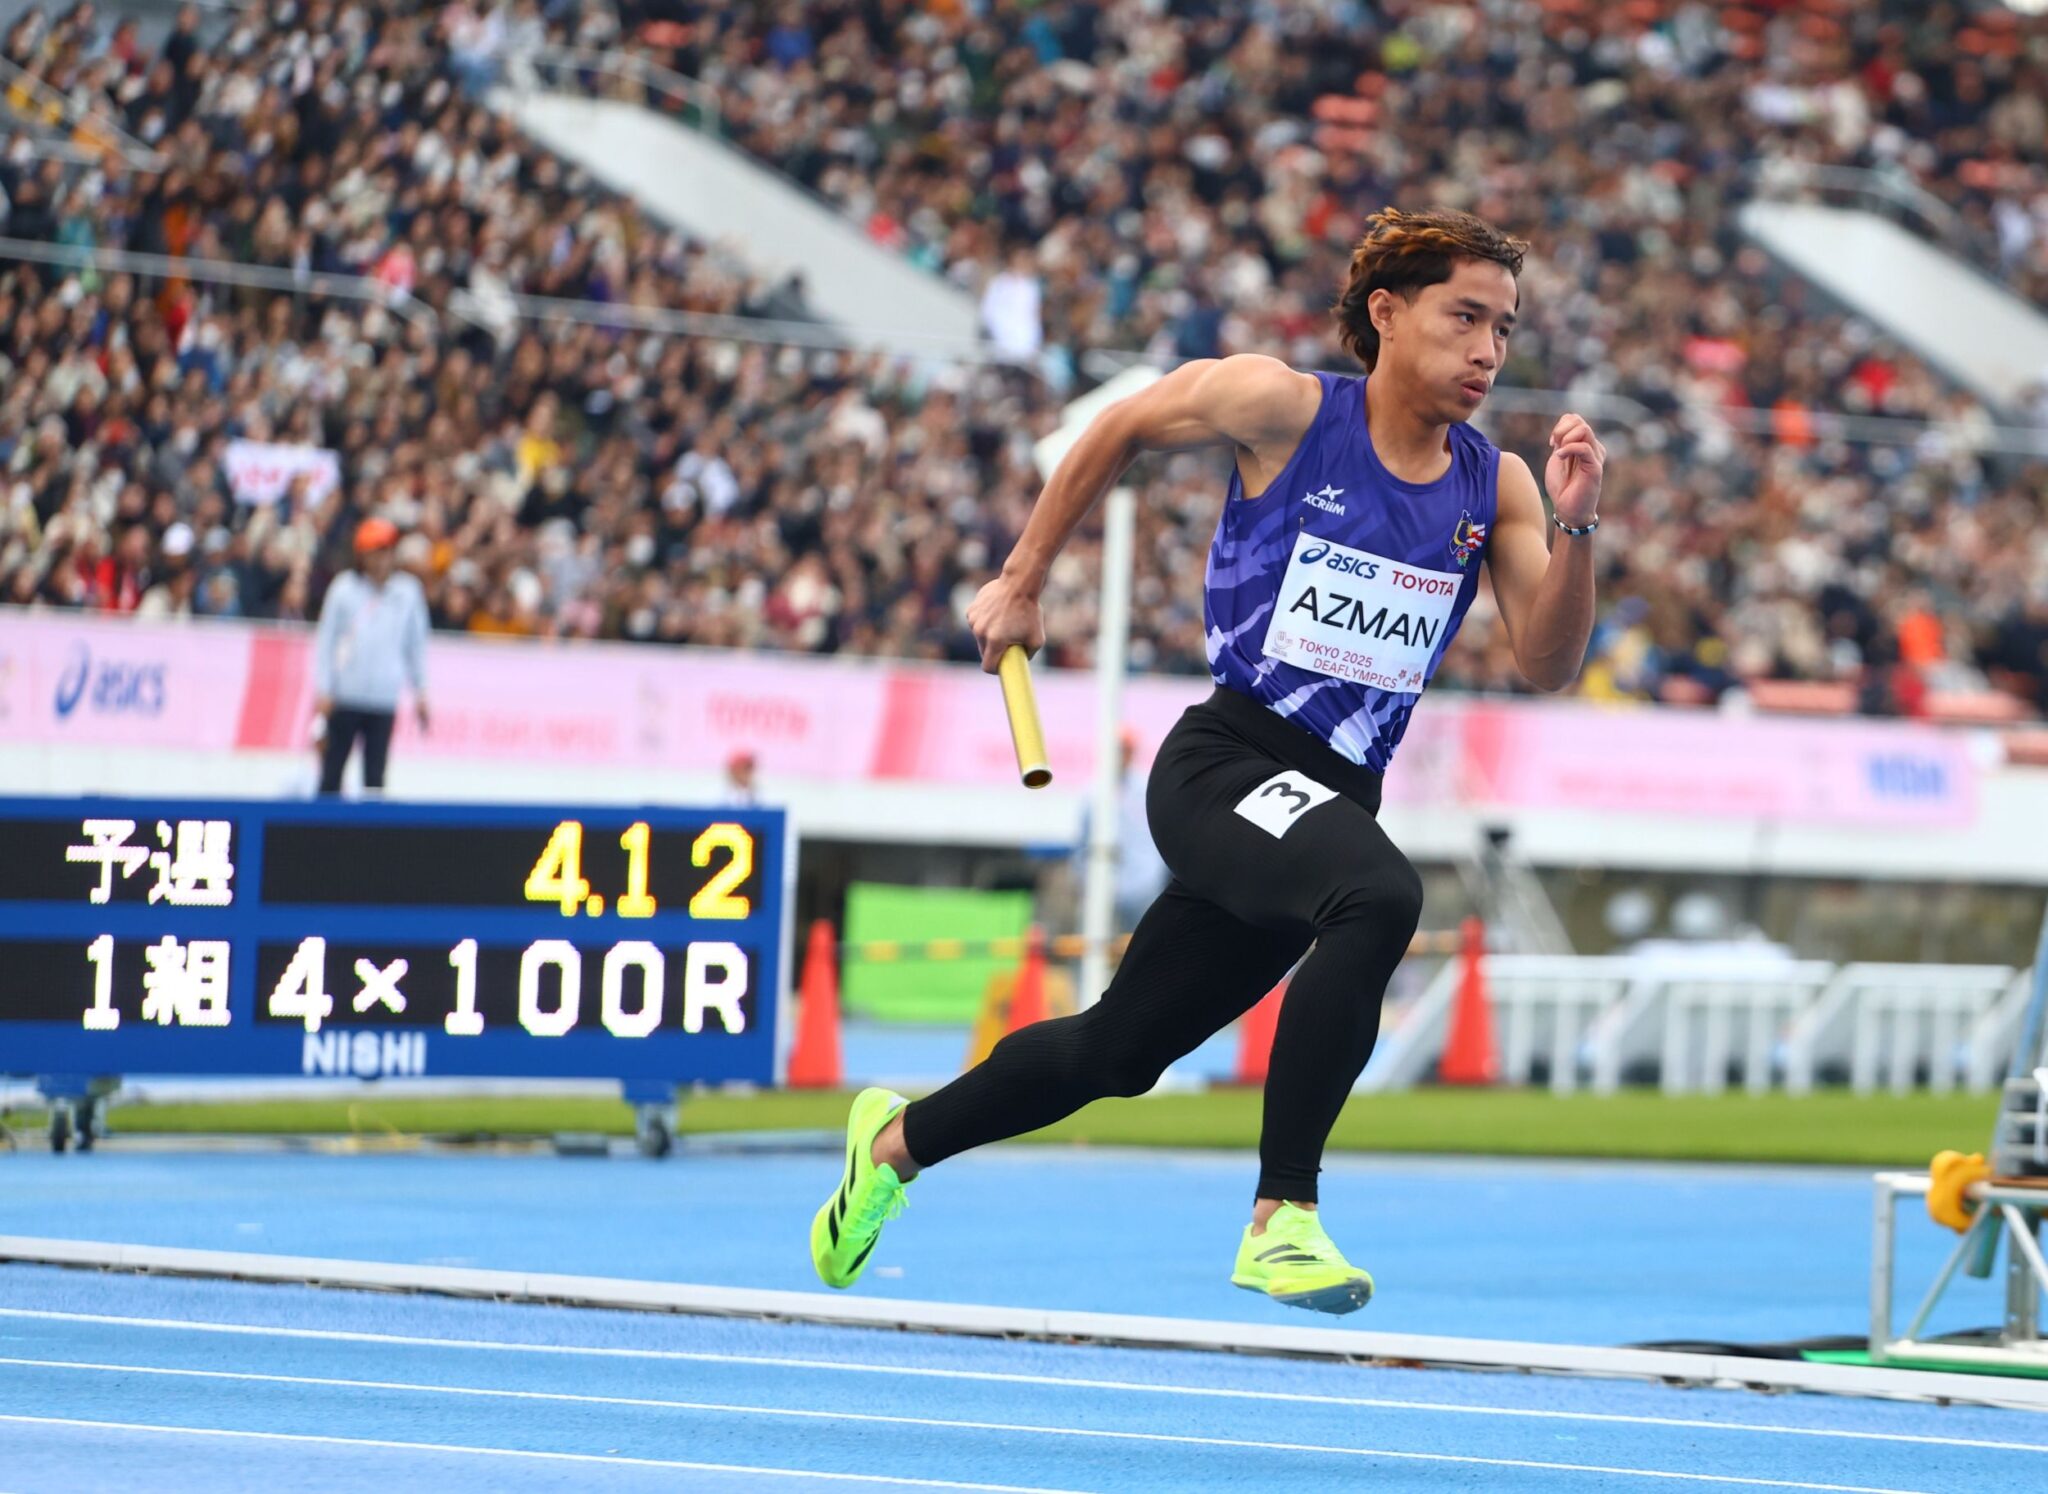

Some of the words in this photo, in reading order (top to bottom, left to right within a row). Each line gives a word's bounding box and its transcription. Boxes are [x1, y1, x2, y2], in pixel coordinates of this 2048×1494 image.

[1326, 554, 1380, 580] asics
[1392, 570, 1454, 597] TOYOTA
[1290, 585, 1439, 649] AZMAN
[1299, 637, 1341, 660] TOKYO
[1342, 650, 1373, 669] 2025
[1313, 657, 1398, 690] DEAFLYMPICS
[1260, 782, 1311, 814] 3
[66, 818, 233, 906] 予選
[83, 933, 230, 1031] 1組
[302, 1031, 427, 1076] NISHI
